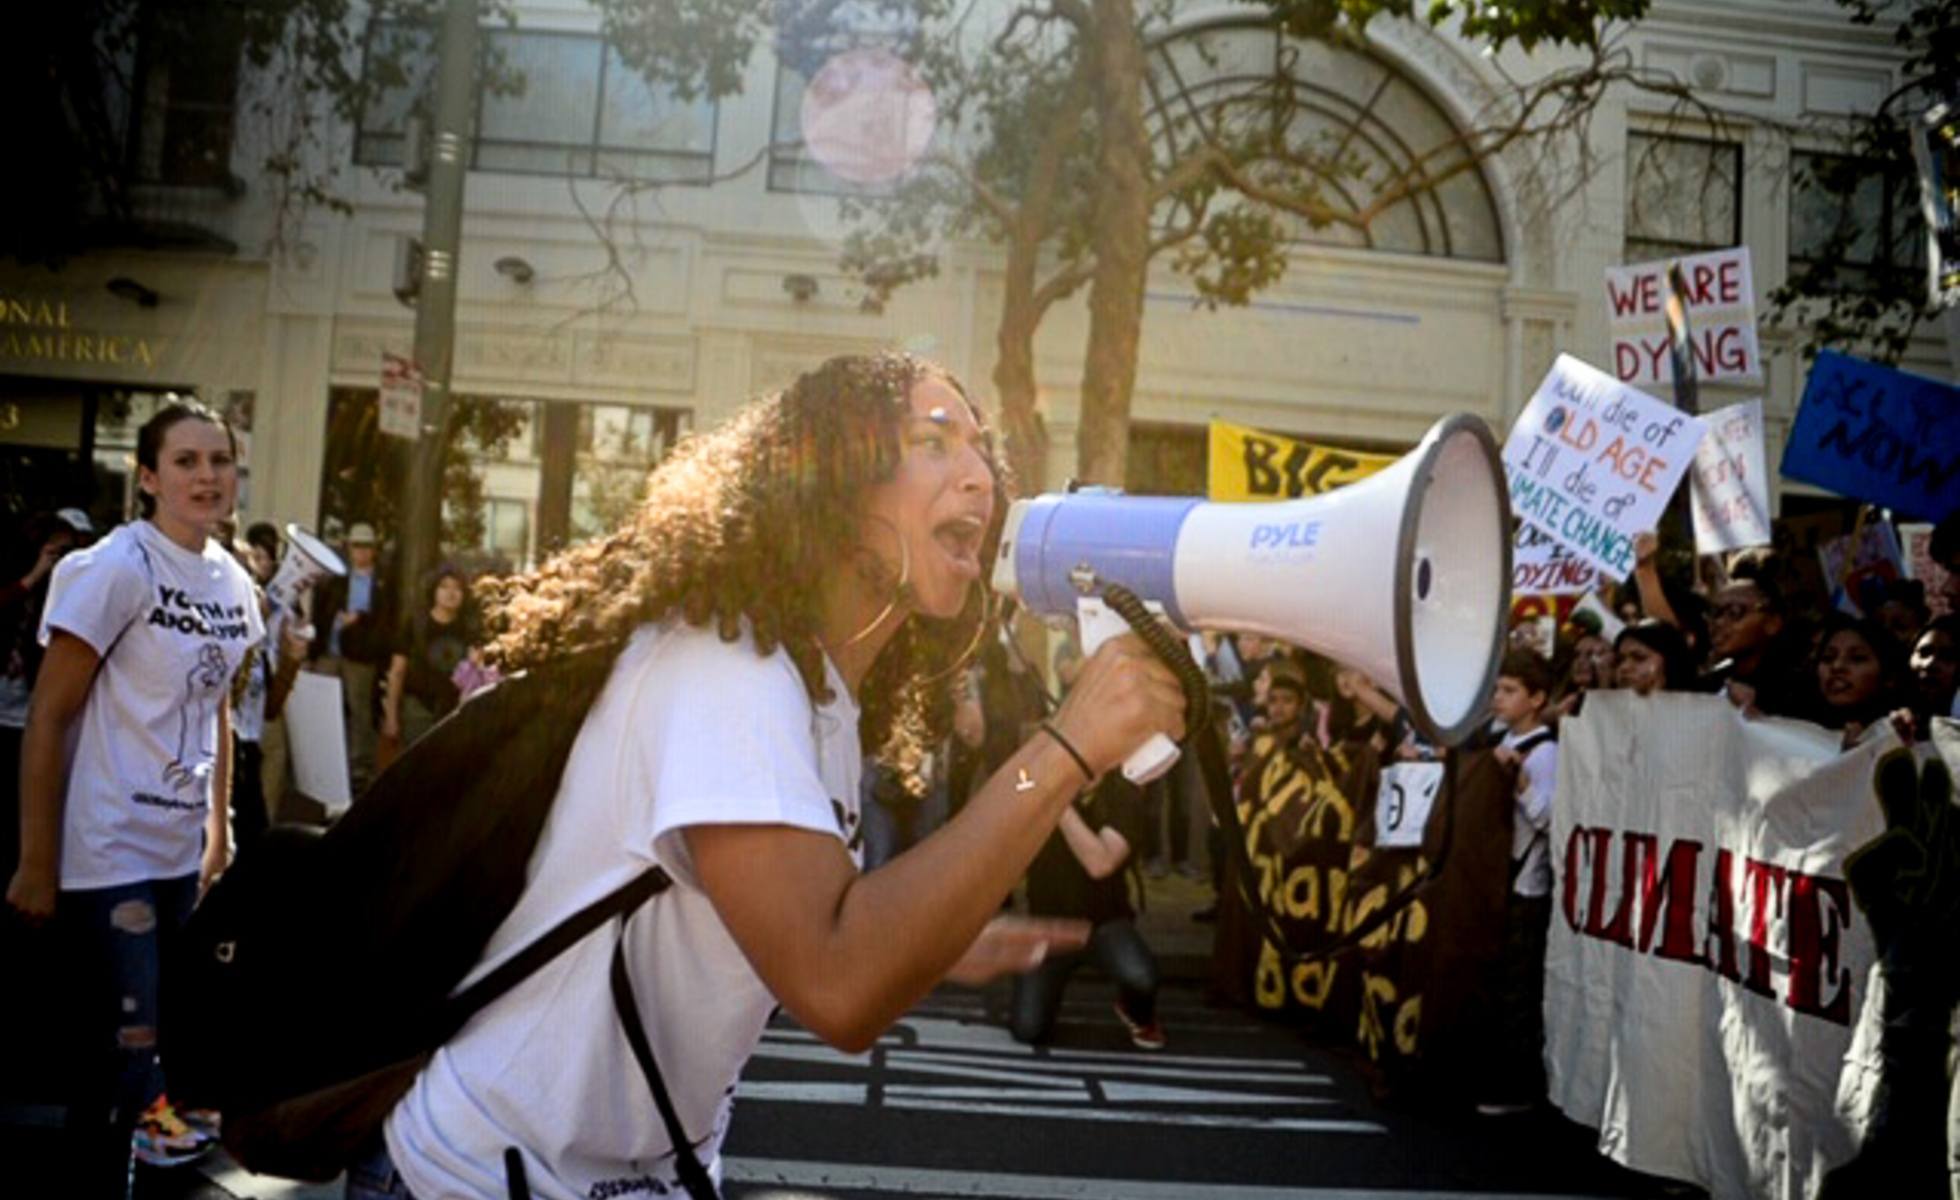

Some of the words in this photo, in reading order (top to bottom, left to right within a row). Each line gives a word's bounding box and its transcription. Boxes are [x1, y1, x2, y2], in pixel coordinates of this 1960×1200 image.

[1607, 275, 1660, 317] WE
[5, 331, 157, 368] AMERICA
[1615, 327, 1747, 383] DYNG
[1544, 404, 1598, 452] OLD
[1597, 435, 1669, 494] AGE
[1602, 394, 1640, 432] die
[1643, 417, 1684, 449] of
[1563, 461, 1597, 504] die
[1562, 504, 1636, 576] CHANGE
[1514, 558, 1595, 590] DYING
[1562, 824, 1852, 1027] CLIMATE
